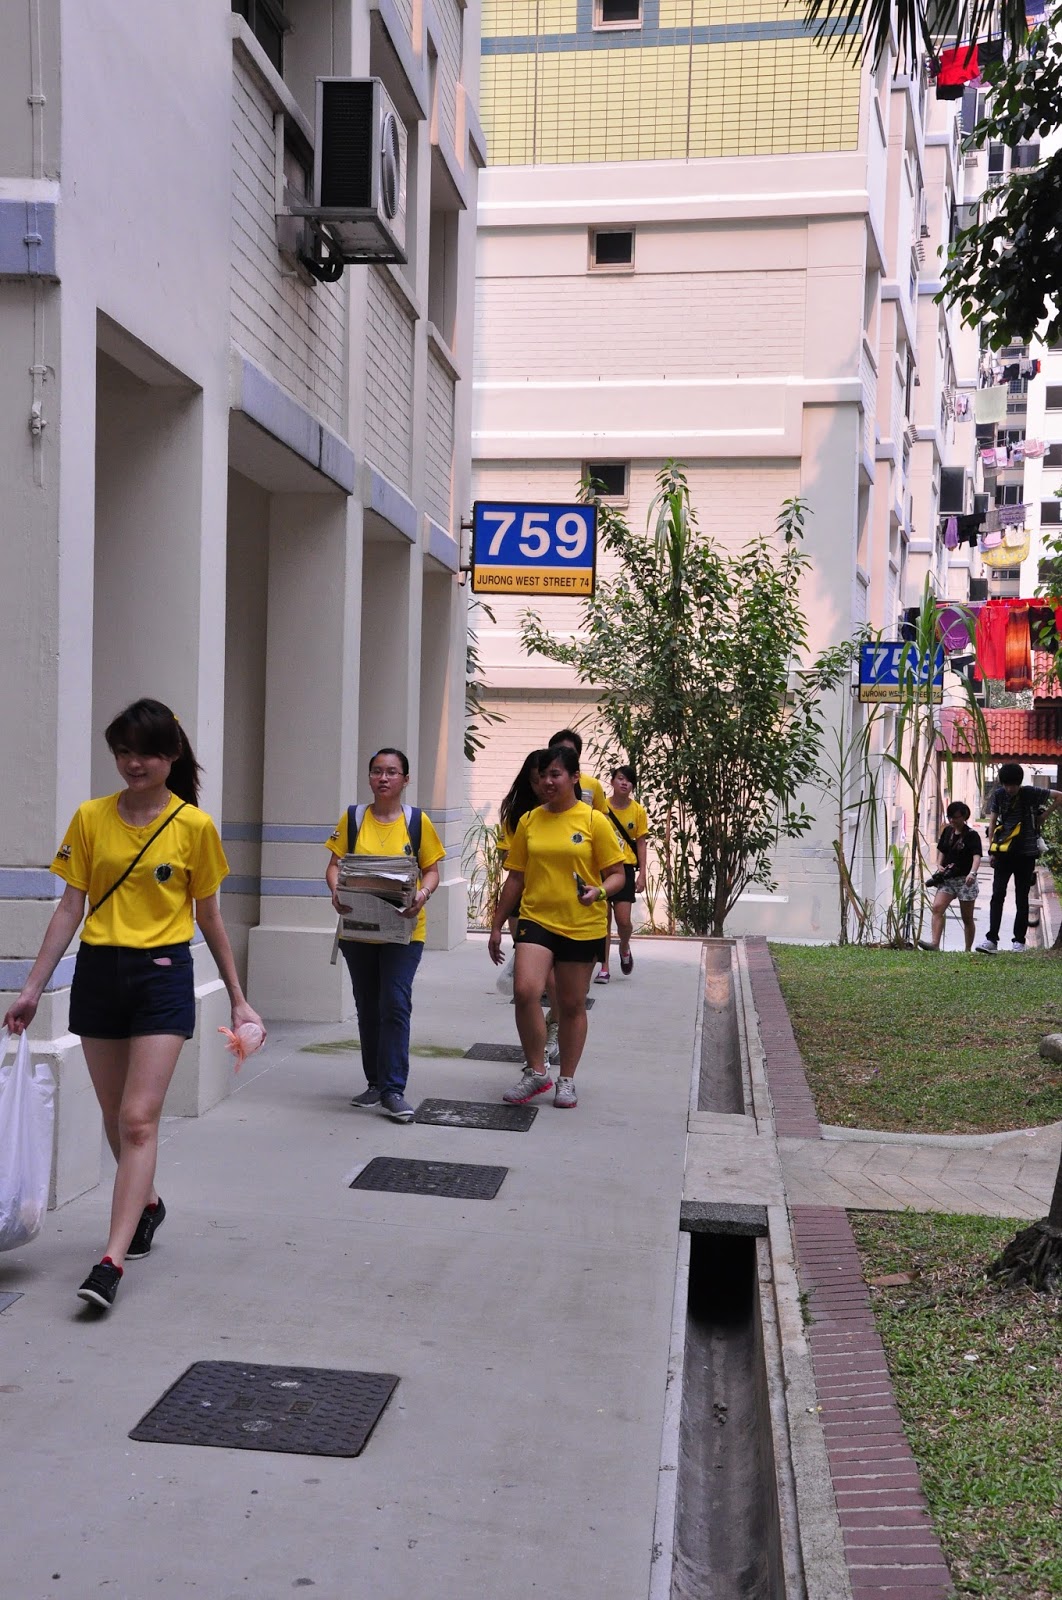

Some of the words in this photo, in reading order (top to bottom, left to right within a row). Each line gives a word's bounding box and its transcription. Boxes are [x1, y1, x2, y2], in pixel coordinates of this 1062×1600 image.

[483, 511, 588, 559] 759
[477, 575, 513, 586] JURONG
[516, 576, 540, 586] WEST
[543, 577, 577, 587] STREET
[580, 578, 589, 587] 74
[862, 690, 887, 698] JURONG
